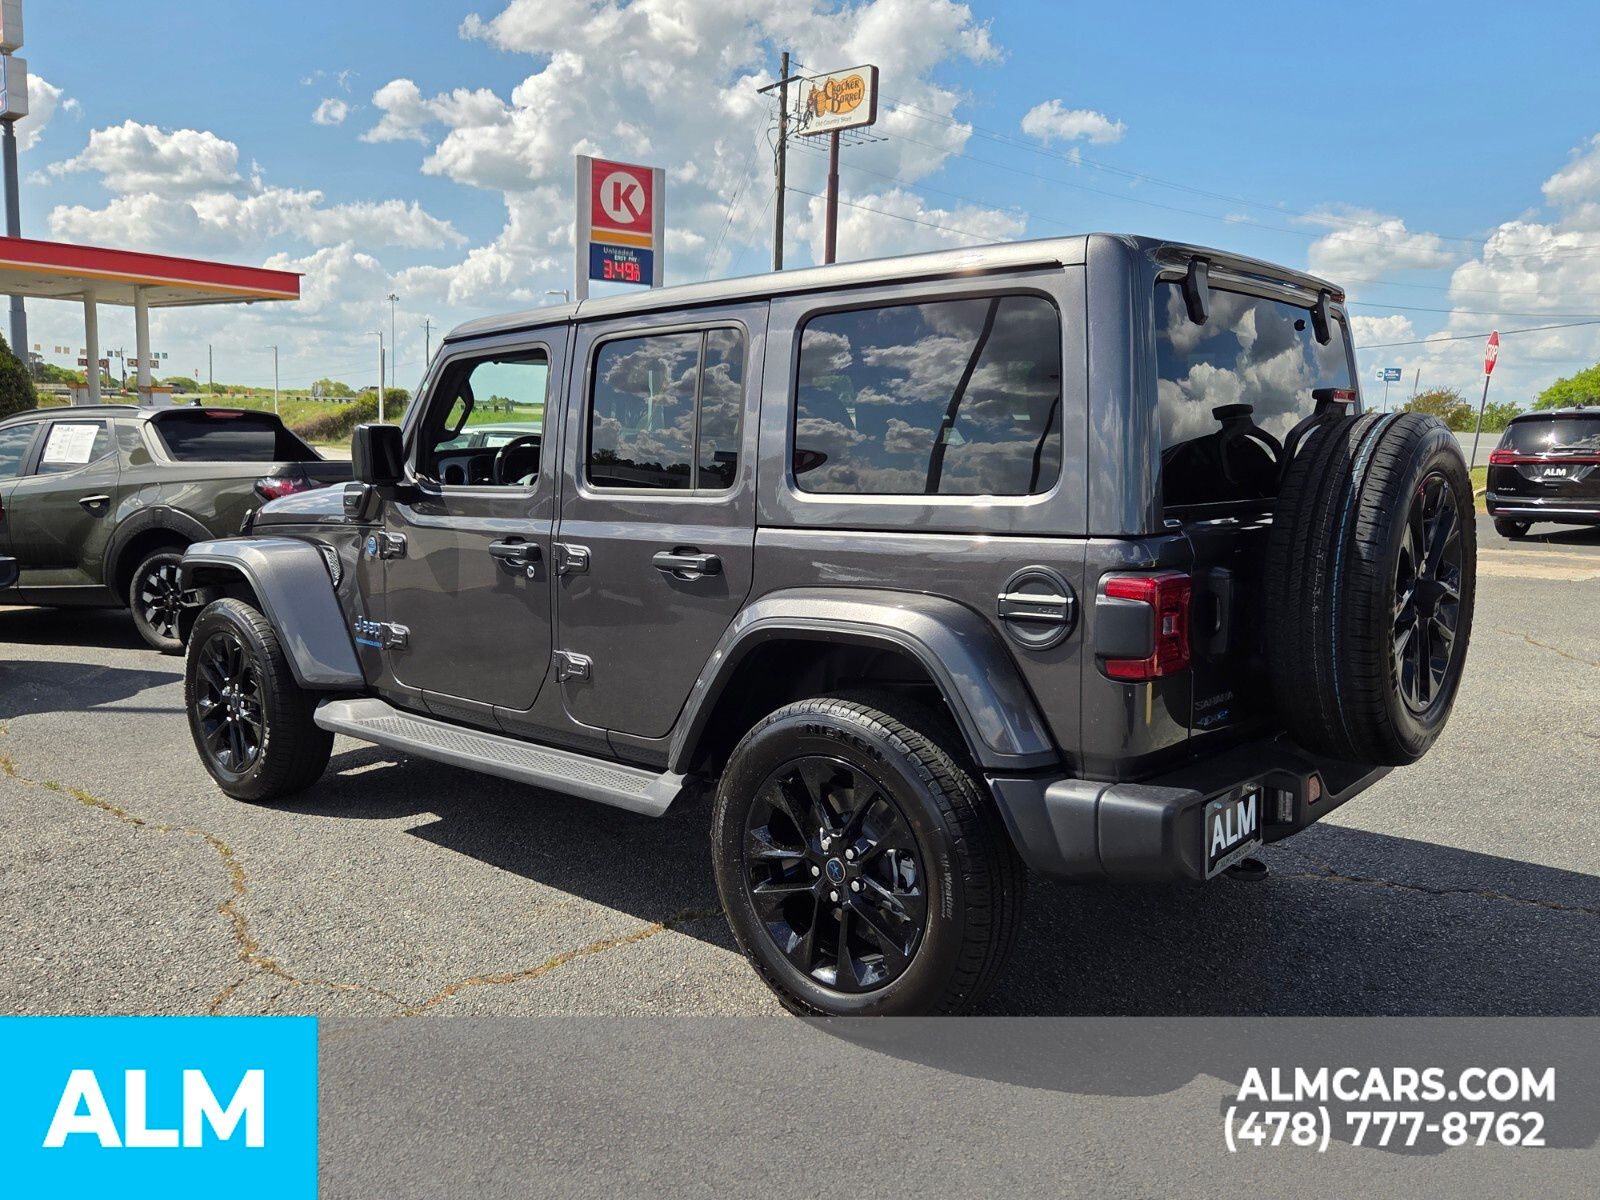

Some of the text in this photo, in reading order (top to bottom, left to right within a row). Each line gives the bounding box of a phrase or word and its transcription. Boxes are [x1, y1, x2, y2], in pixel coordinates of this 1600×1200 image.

[824, 79, 860, 99] Cracker
[831, 89, 862, 113] Barrel
[612, 181, 640, 221] K
[603, 246, 634, 256] Unleaded
[1485, 343, 1498, 361] STOP
[1543, 467, 1566, 476] ALM
[1194, 691, 1233, 710] SAHARA
[805, 724, 883, 761] NEXEN
[1210, 794, 1256, 857] ALM
